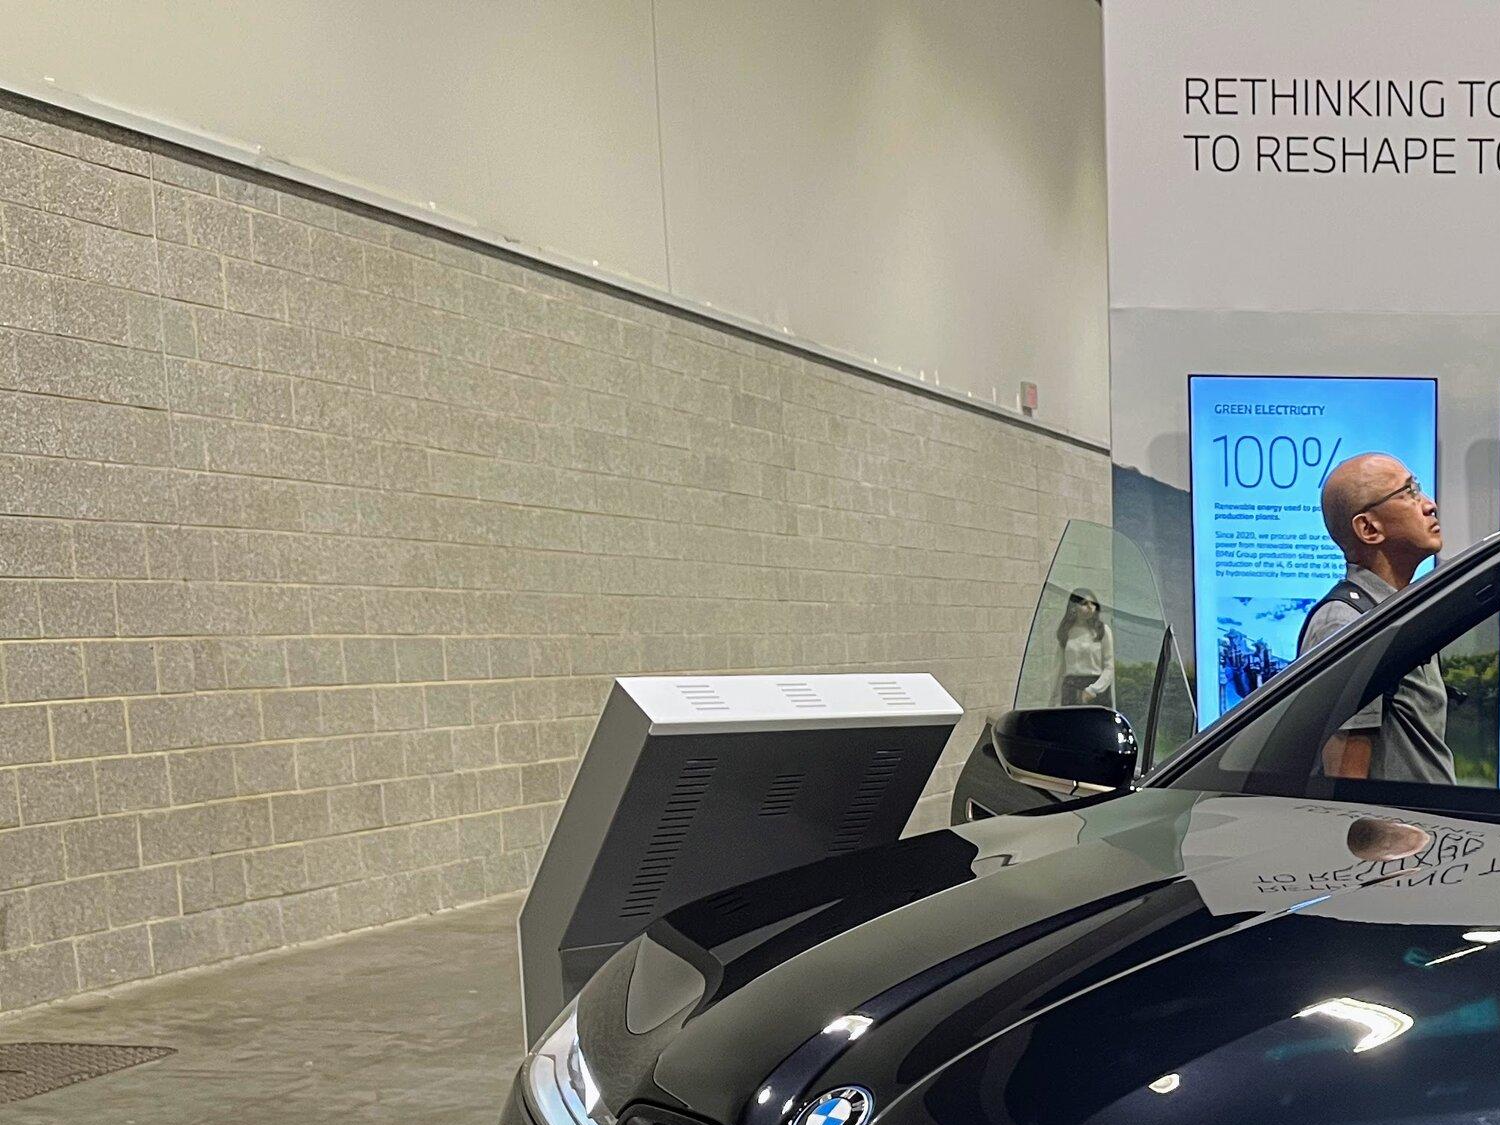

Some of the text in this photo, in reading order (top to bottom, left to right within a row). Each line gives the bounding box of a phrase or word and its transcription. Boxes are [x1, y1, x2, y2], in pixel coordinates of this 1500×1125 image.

[1183, 77, 1446, 119] RETHINKING
[1183, 134, 1241, 173] TO
[1255, 135, 1458, 175] RESHAPE
[1214, 404, 1326, 417] GREEN ELECTRICITY
[1212, 434, 1343, 490] 100%
